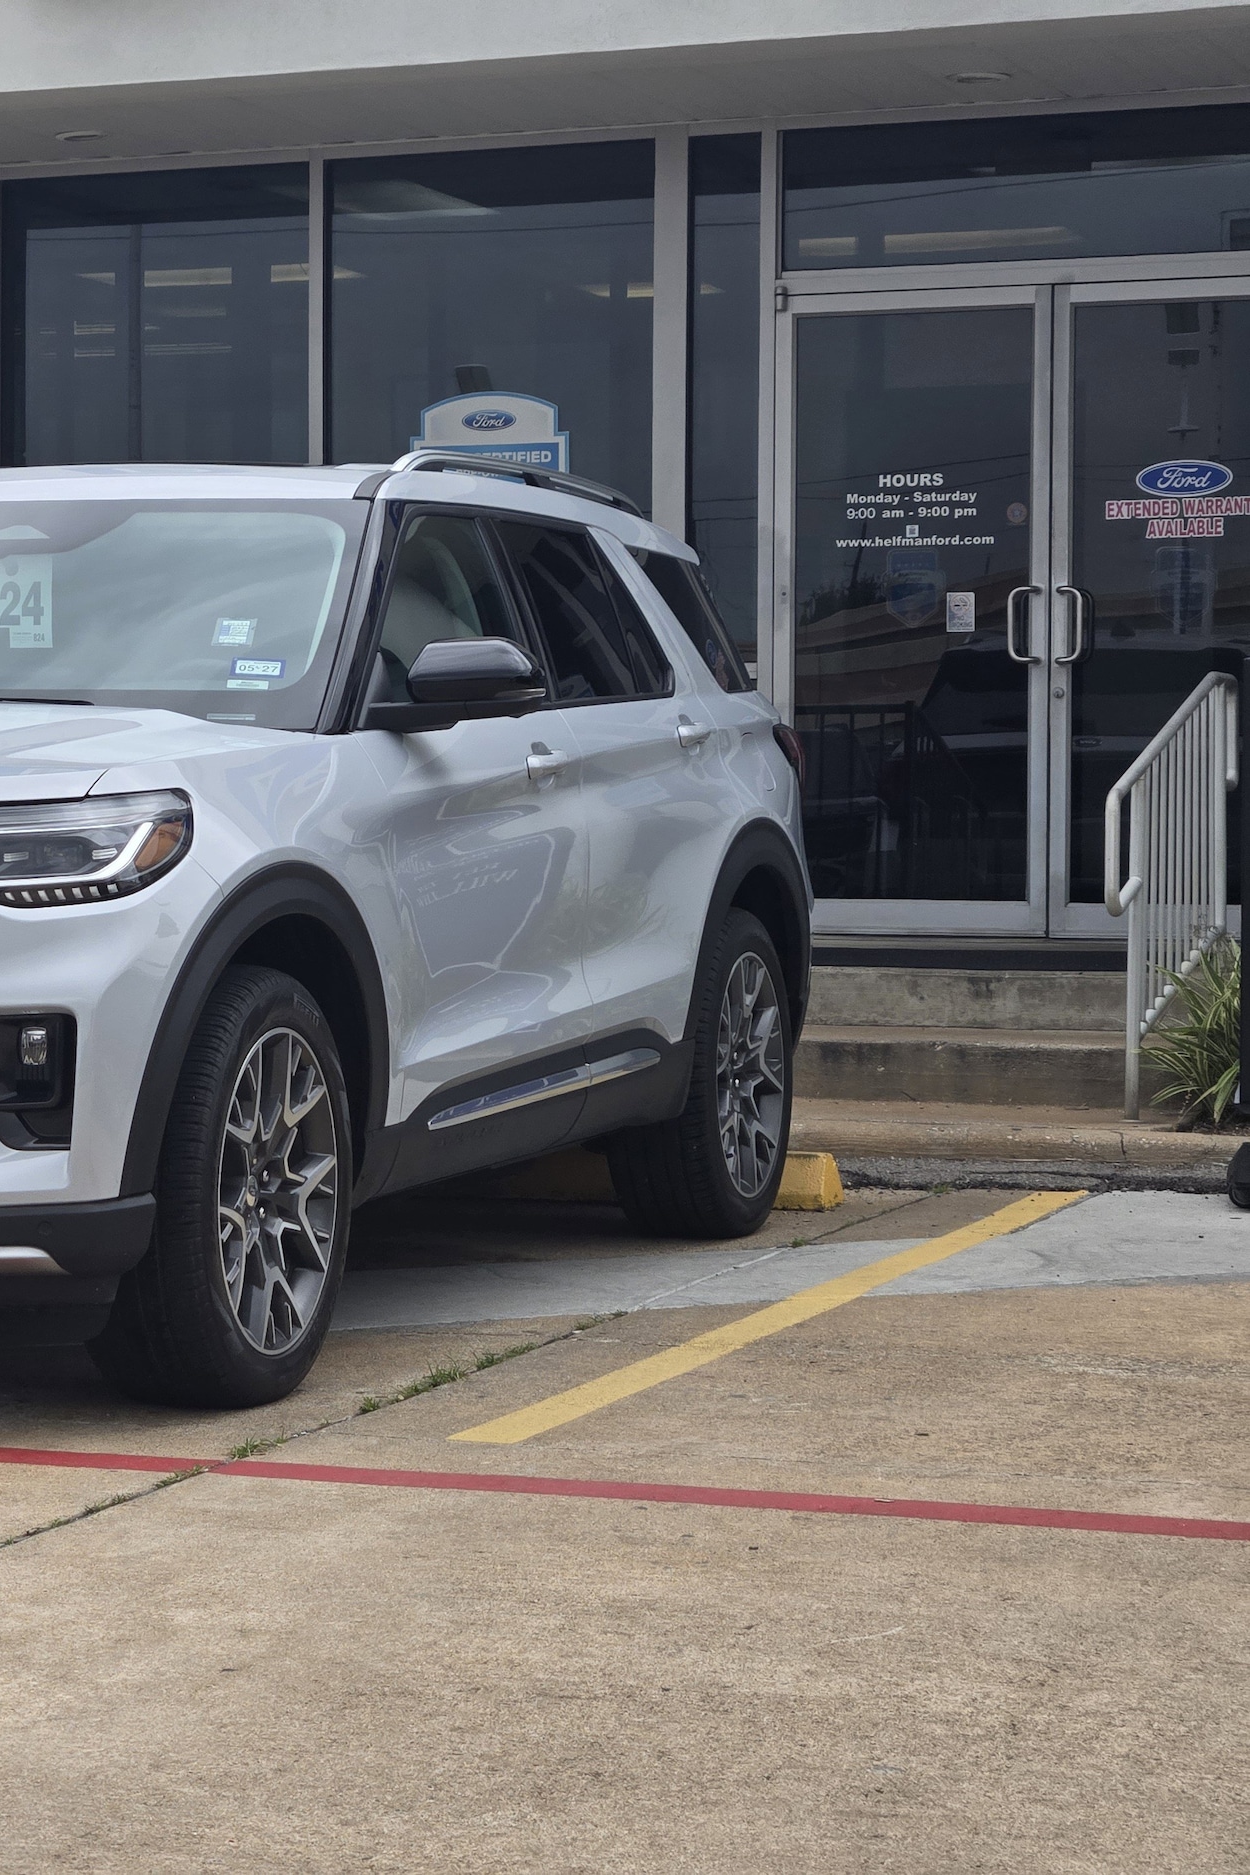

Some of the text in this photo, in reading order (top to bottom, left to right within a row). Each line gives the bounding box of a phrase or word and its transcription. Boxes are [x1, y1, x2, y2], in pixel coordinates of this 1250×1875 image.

[475, 450, 552, 463] TIFIED
[878, 473, 944, 488] HOURS
[846, 493, 901, 505] Monday
[912, 491, 977, 503] Saturday
[846, 507, 876, 519] 9:00
[881, 509, 904, 518] am
[917, 506, 950, 517] 9:00
[953, 506, 977, 519] pm
[1106, 498, 1180, 520] EXTENDED
[1145, 517, 1224, 539] AVAILABLE
[835, 535, 995, 548] www.helfmanford.com
[33, 632, 45, 642] 824
[238, 664, 279, 673] 05 27
